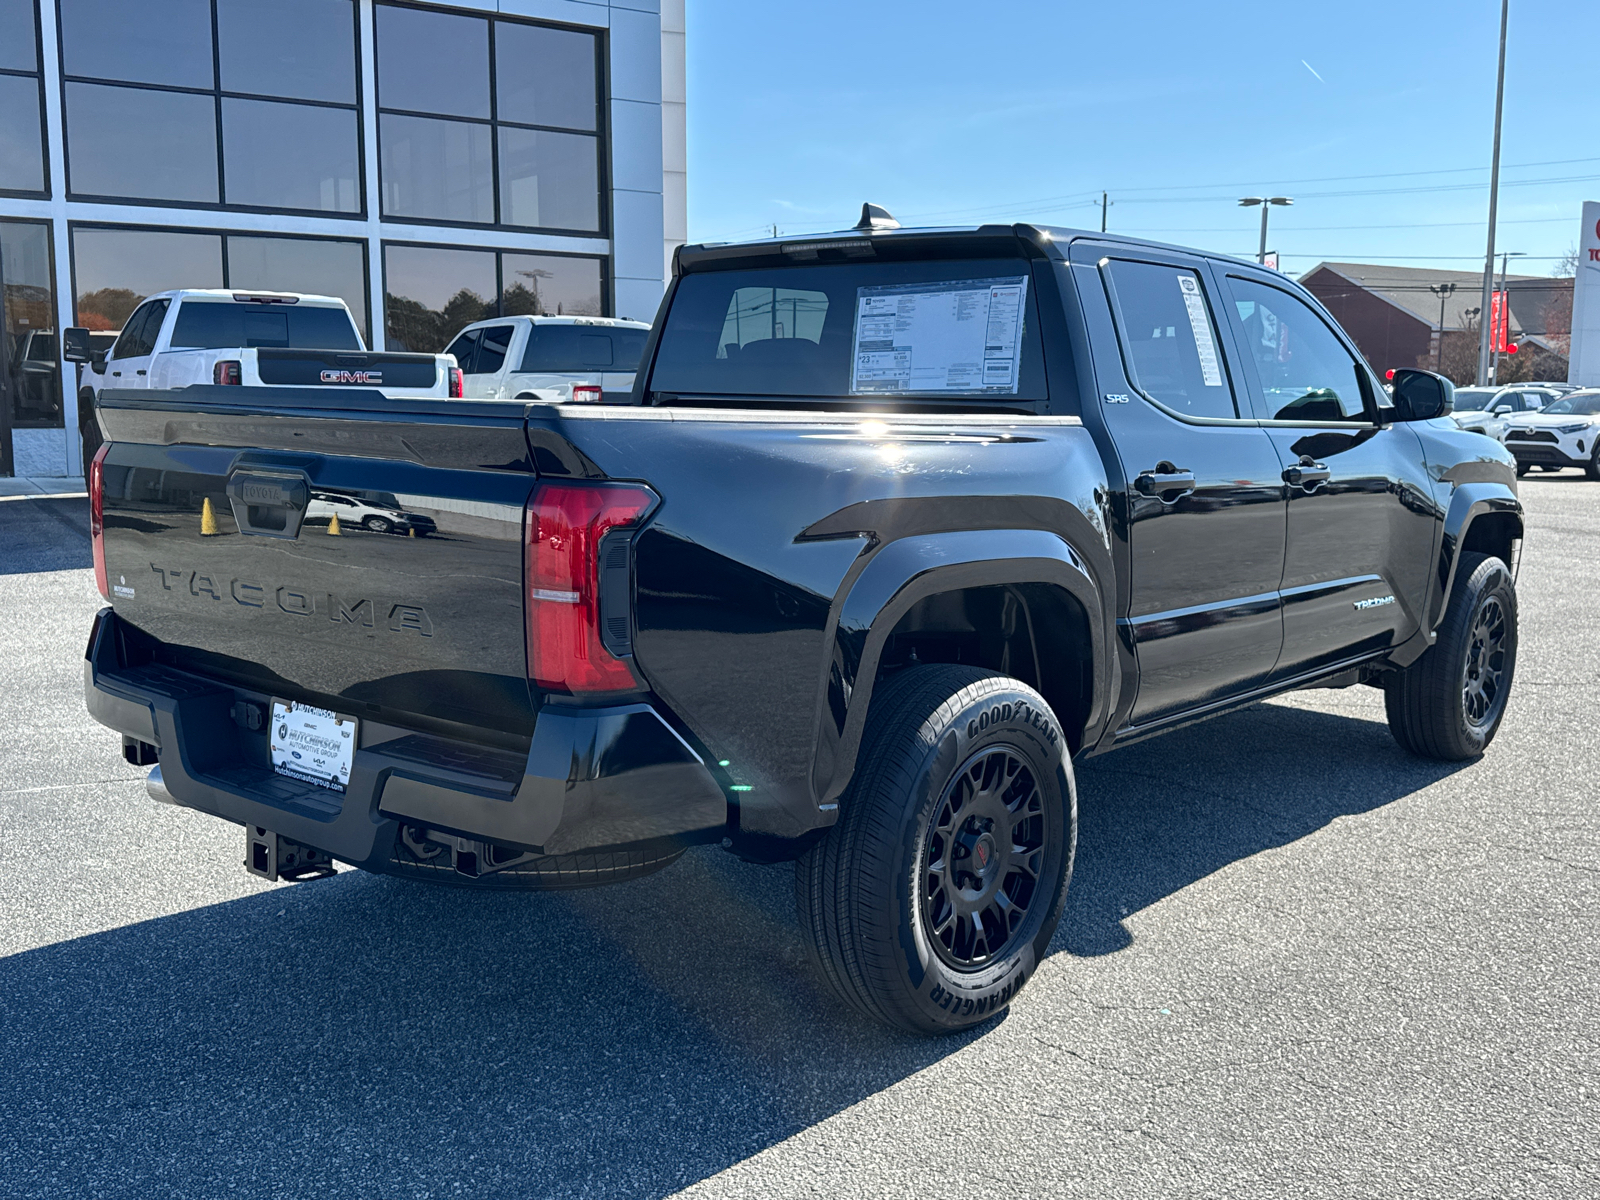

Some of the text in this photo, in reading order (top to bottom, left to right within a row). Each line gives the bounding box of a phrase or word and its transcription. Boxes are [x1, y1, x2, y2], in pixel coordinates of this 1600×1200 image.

[320, 369, 383, 384] GMC
[244, 485, 280, 501] TOYOTA
[149, 561, 434, 638] TACOMA
[299, 702, 337, 719] HUTCHINSON
[289, 729, 341, 752] HUTCHINSON
[289, 741, 320, 755] AUTOMOTIVE
[320, 748, 338, 759] GROUP
[929, 970, 1026, 1017] WRANGLER
